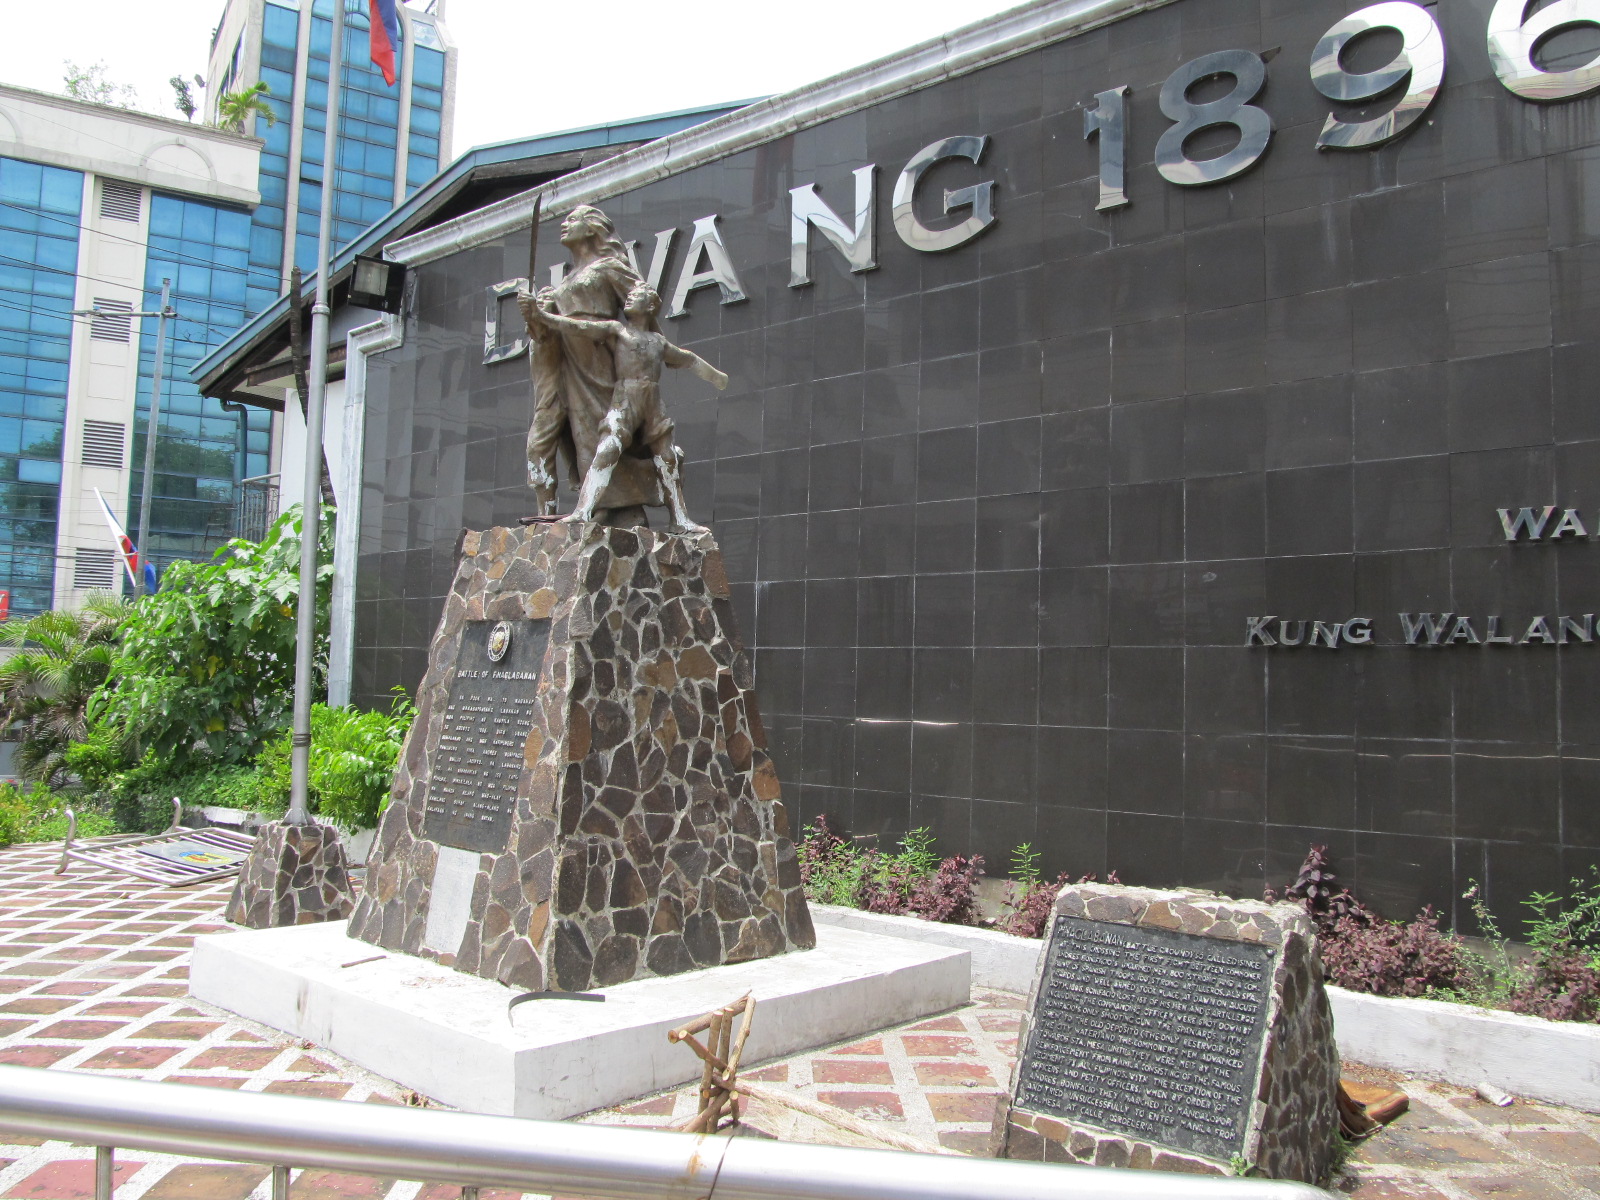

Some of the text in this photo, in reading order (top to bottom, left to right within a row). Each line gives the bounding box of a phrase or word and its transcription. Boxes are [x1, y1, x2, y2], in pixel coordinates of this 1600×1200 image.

[788, 134, 1001, 288] NG
[1083, 0, 1600, 211] 1896
[1496, 505, 1600, 542] WA
[1244, 611, 1600, 648] KUNG WALAN
[1123, 950, 1140, 960] THE
[1089, 1018, 1104, 1029] OLD
[1224, 1046, 1241, 1057] FOR
[1062, 1067, 1079, 1078] AND
[1080, 1071, 1106, 1084] PETTY
[1212, 1066, 1231, 1078] THE
[1210, 1078, 1242, 1093] FAMOUS
[1224, 1093, 1242, 1105] THE
